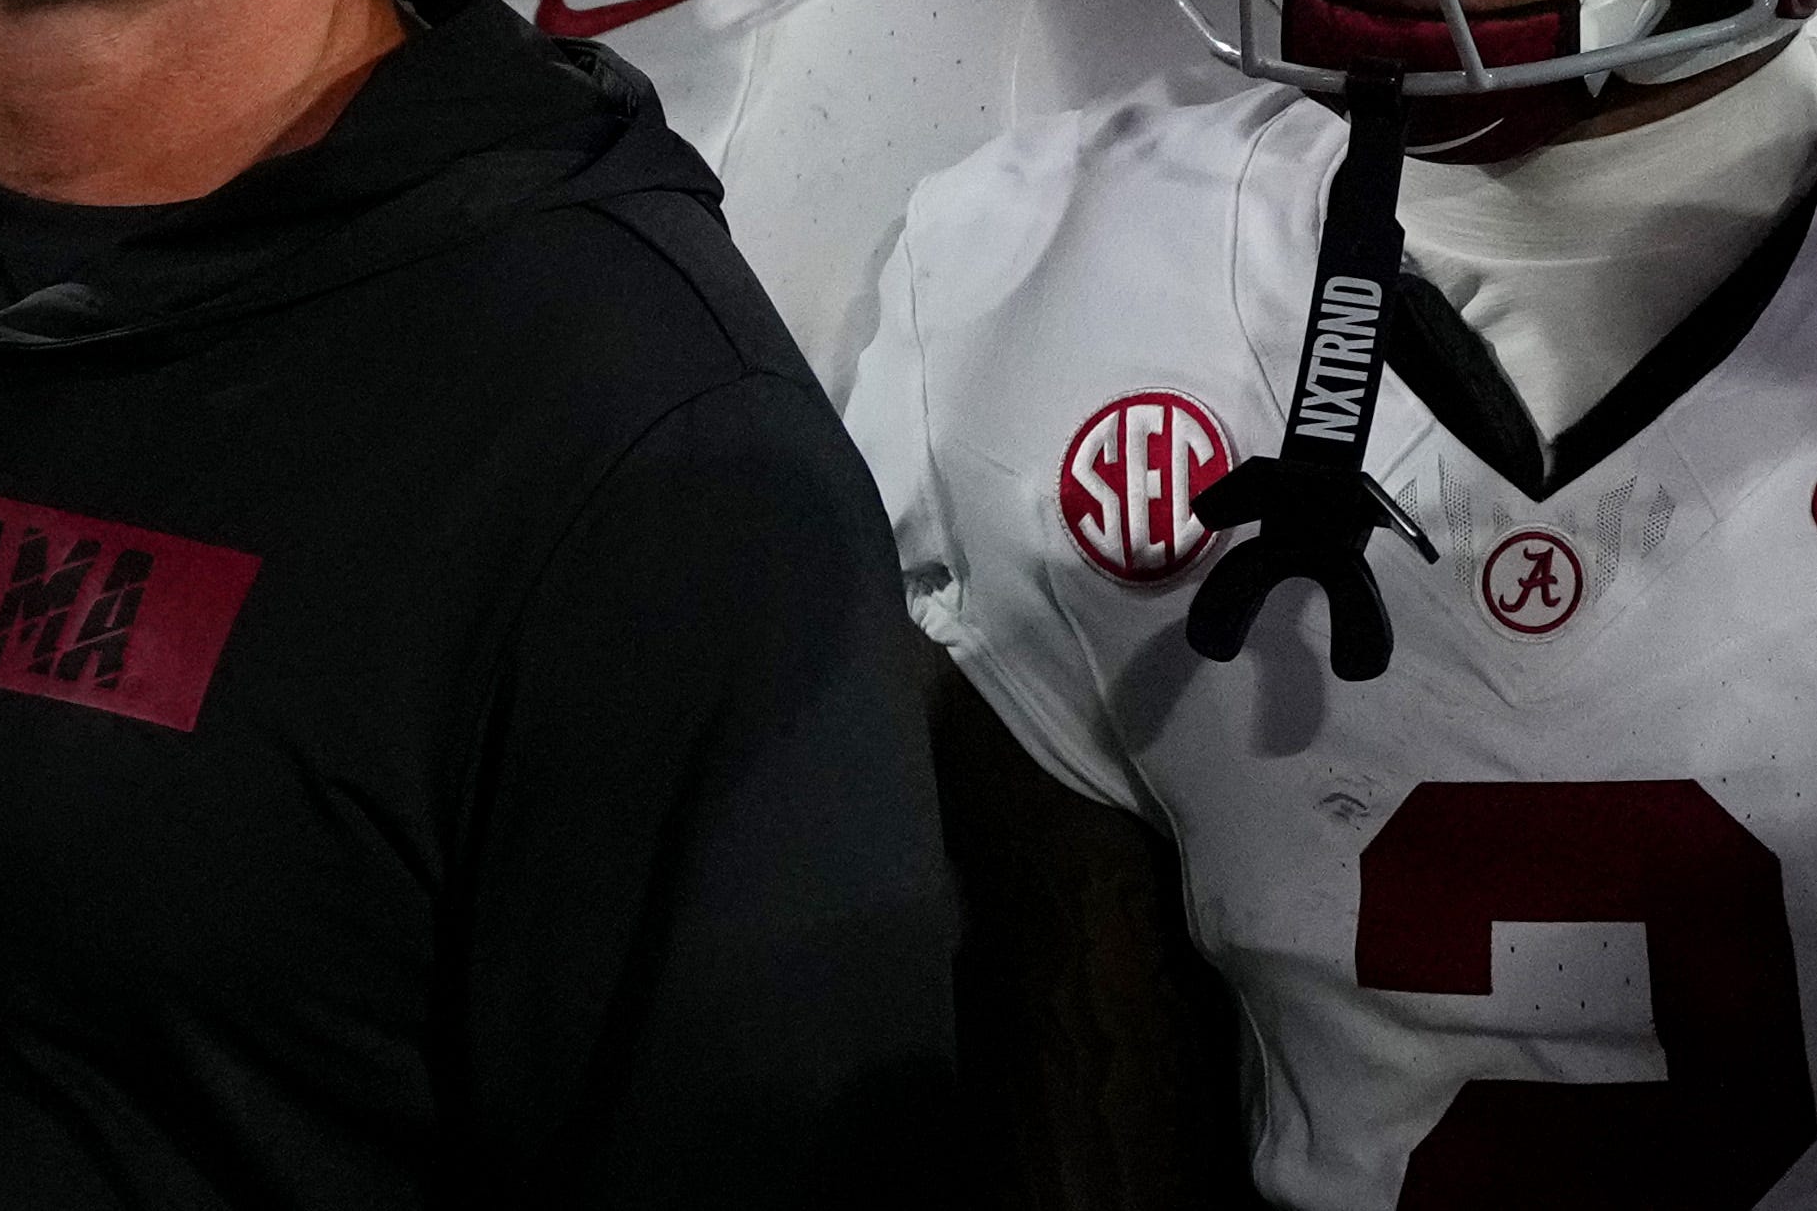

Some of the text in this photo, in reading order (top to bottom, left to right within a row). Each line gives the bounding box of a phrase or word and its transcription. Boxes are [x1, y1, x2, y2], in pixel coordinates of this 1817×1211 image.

[1294, 275, 1383, 442] NXTRND
[1068, 402, 1215, 575] SEC
[1355, 779, 1817, 1211] 2
